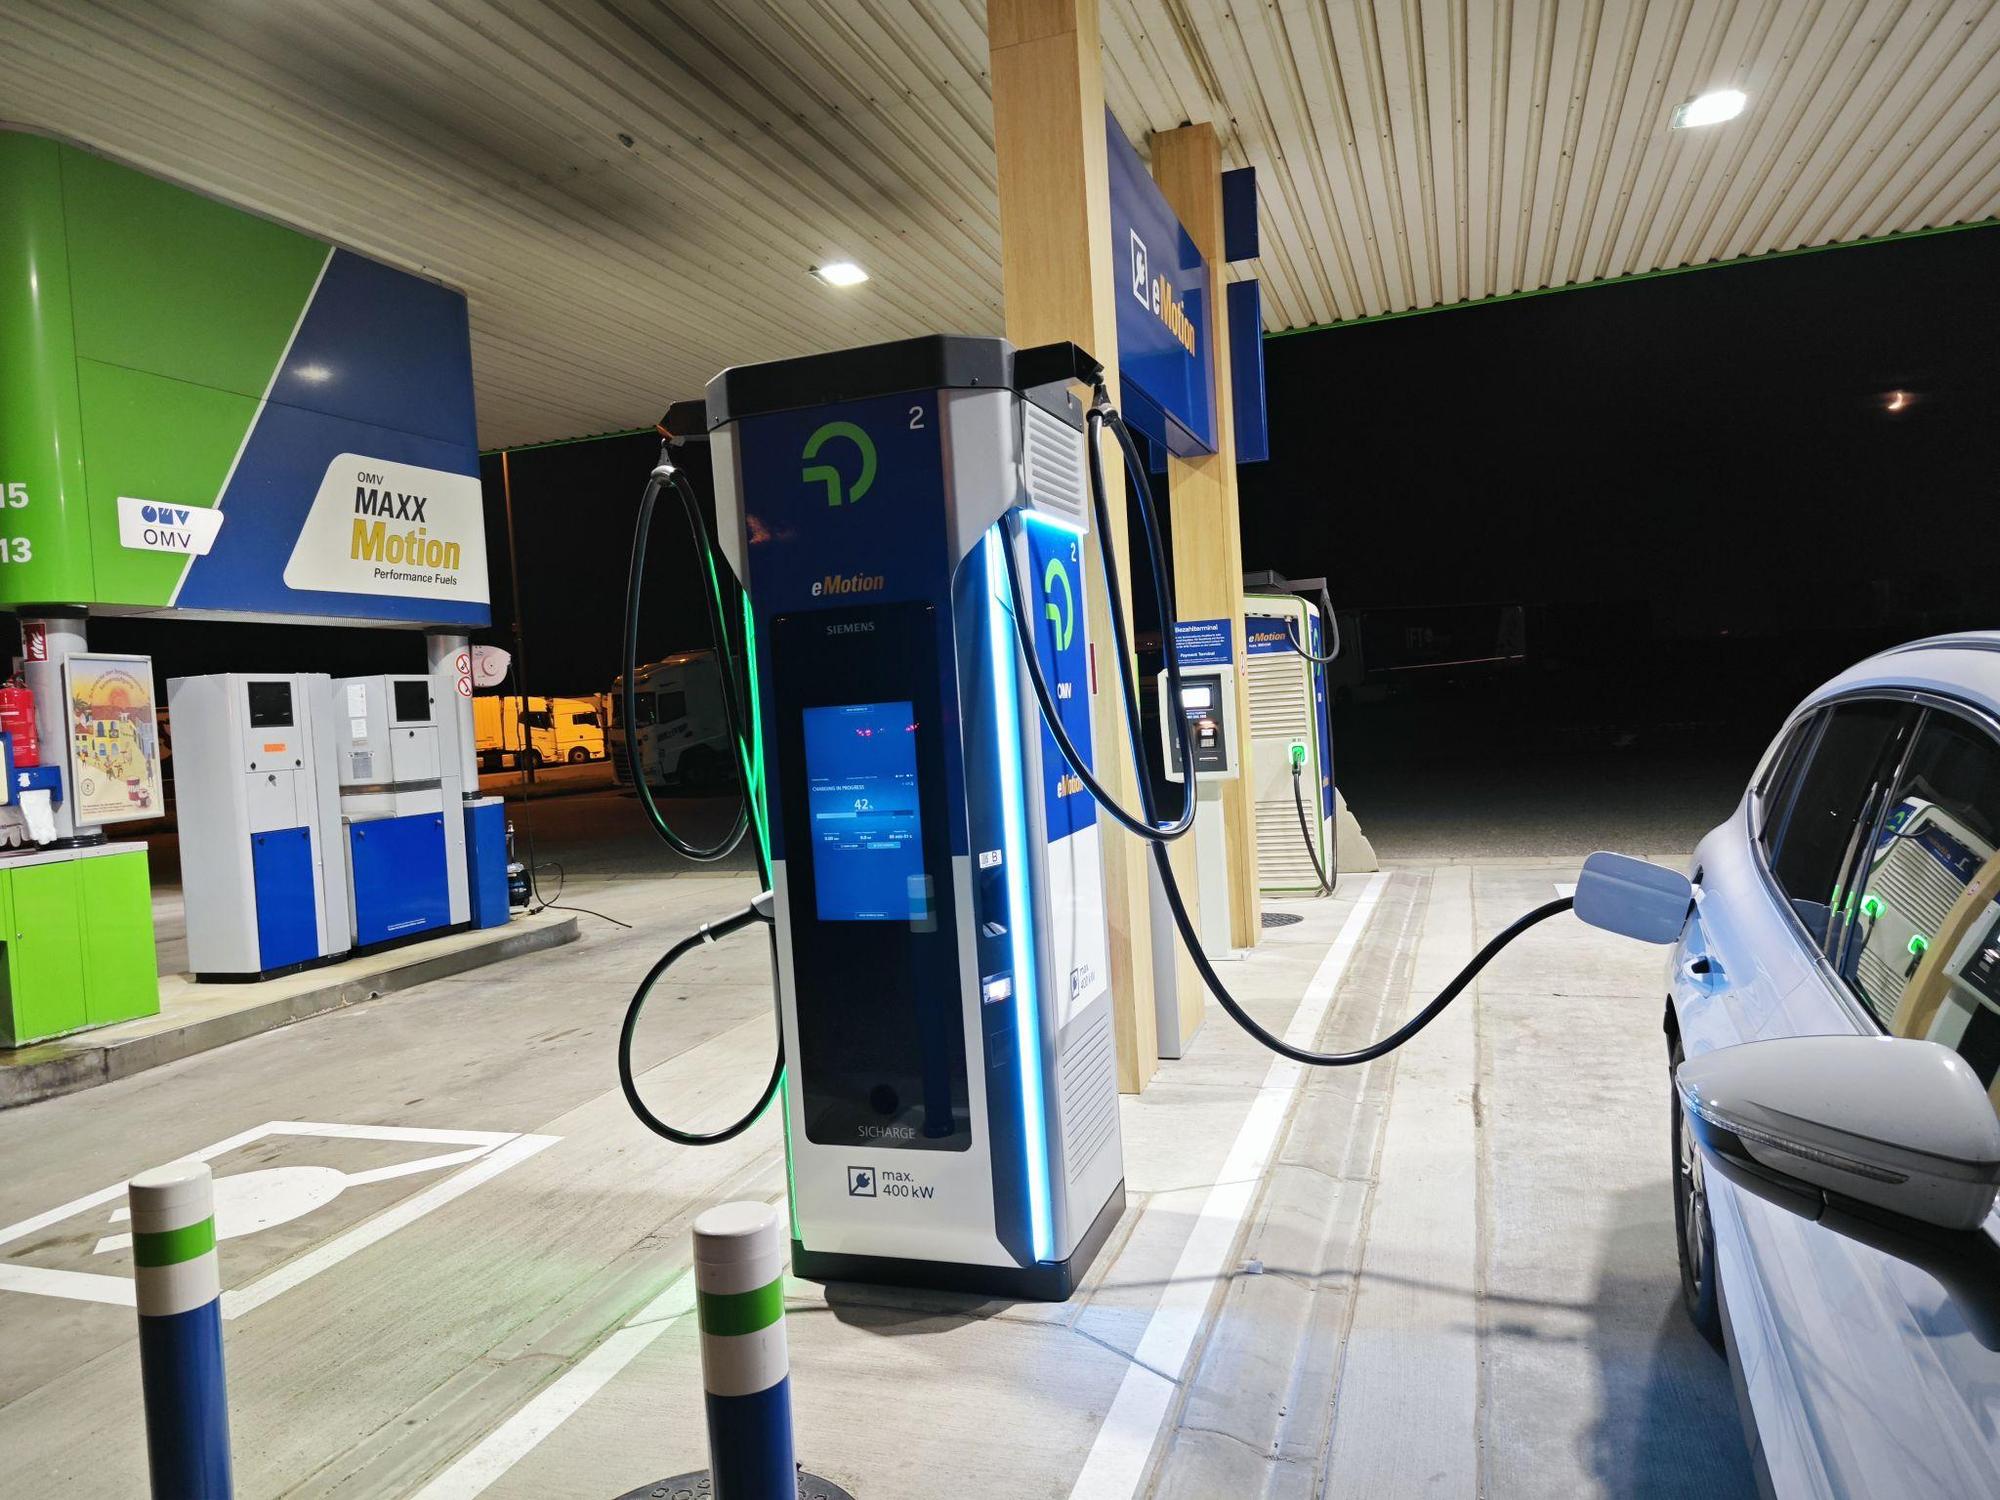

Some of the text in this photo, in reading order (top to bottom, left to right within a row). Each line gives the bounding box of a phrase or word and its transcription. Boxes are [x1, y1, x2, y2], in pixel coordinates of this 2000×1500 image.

[1152, 273, 1195, 357] eMotion
[908, 406, 925, 430] 2
[357, 471, 384, 485] OMV
[355, 486, 428, 523] MAXX
[143, 528, 191, 548] OMV
[351, 518, 461, 570] Motion
[0, 536, 32, 563] 13
[1070, 541, 1077, 562] 2
[374, 567, 458, 586] Performance Fuels
[811, 572, 885, 596] eMotion
[826, 621, 876, 635] SIEMENS
[1248, 632, 1286, 643] eMotion
[1057, 682, 1072, 699] OMV
[1057, 773, 1084, 798] eMotion
[857, 1125, 916, 1140] SICHARGE
[882, 1170, 914, 1182] max.
[882, 1184, 934, 1199] 400 kW
